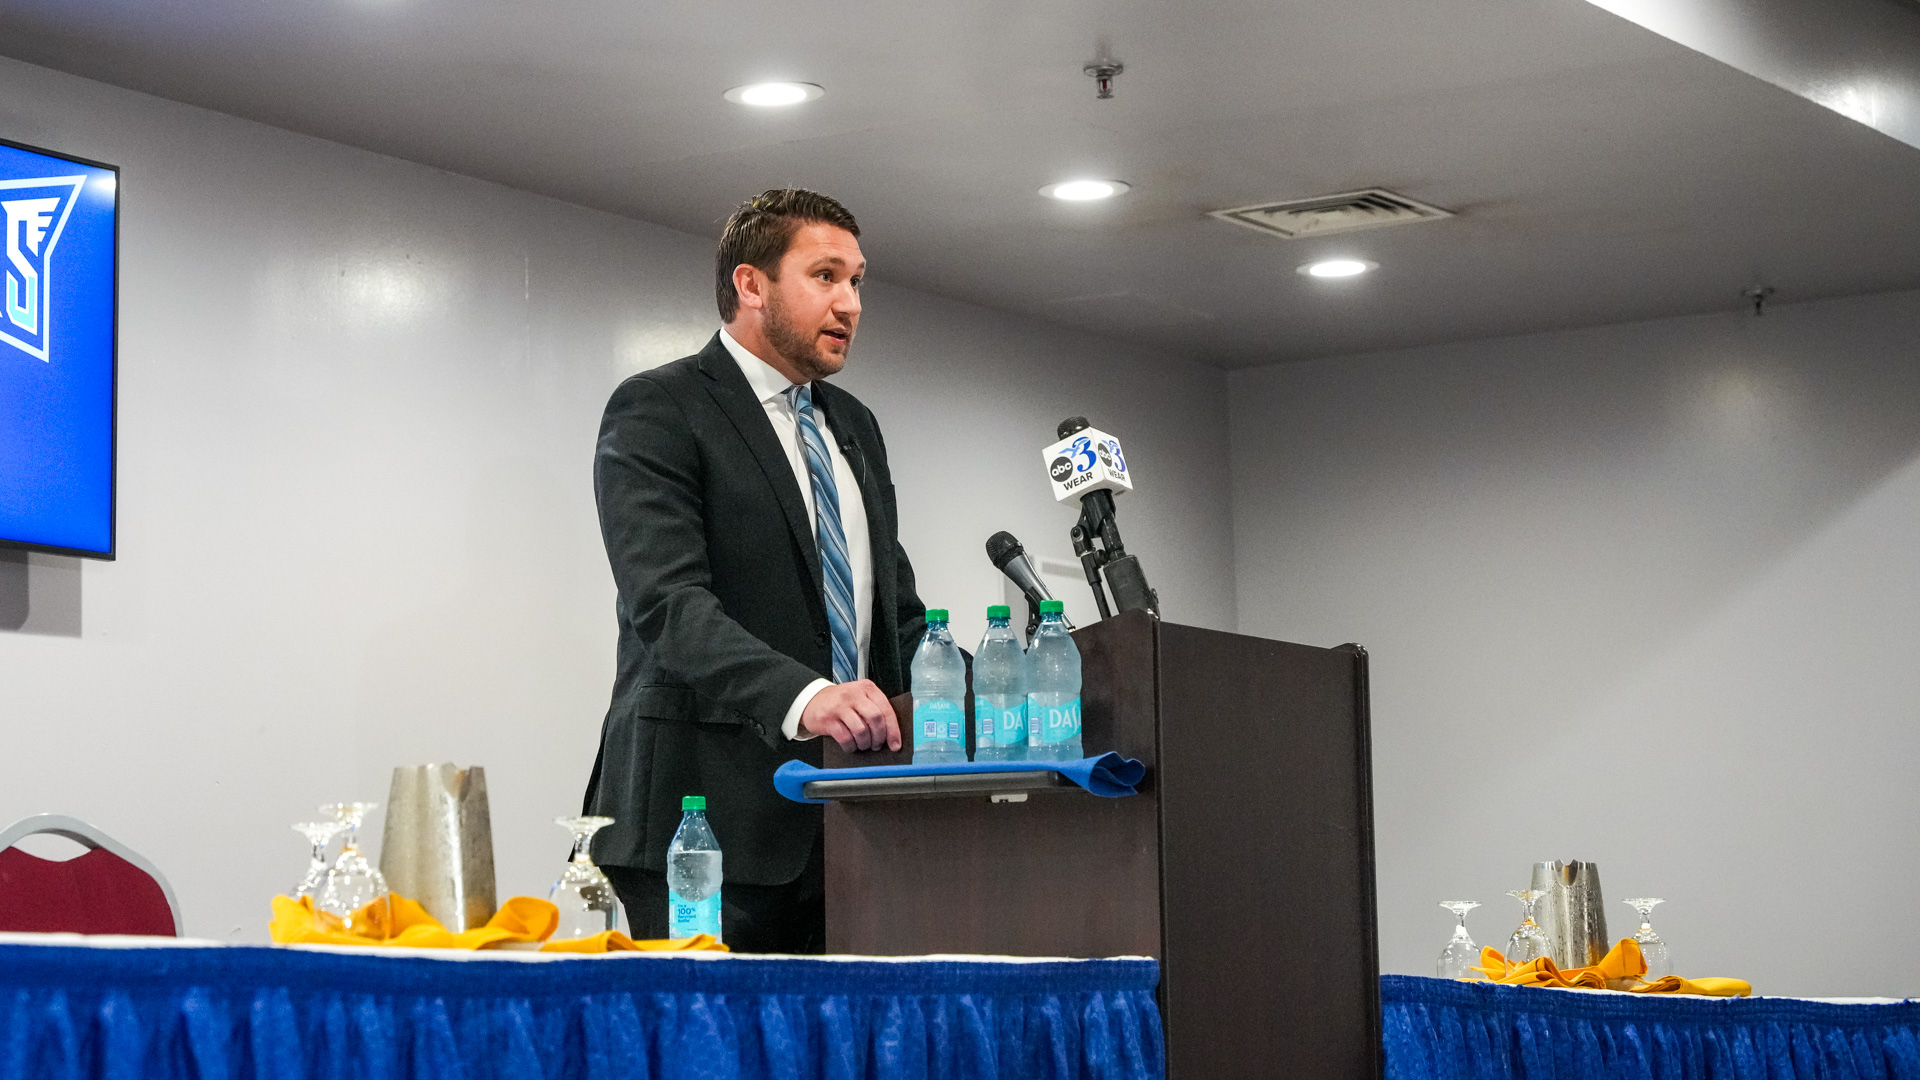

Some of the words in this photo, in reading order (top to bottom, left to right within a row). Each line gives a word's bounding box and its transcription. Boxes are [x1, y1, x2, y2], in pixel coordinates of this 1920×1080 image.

[1051, 462, 1072, 477] abc
[1072, 436, 1097, 473] 3
[1109, 439, 1126, 473] 3
[1063, 471, 1094, 491] WEAR
[1108, 468, 1127, 482] WEAR
[1003, 708, 1026, 730] DA
